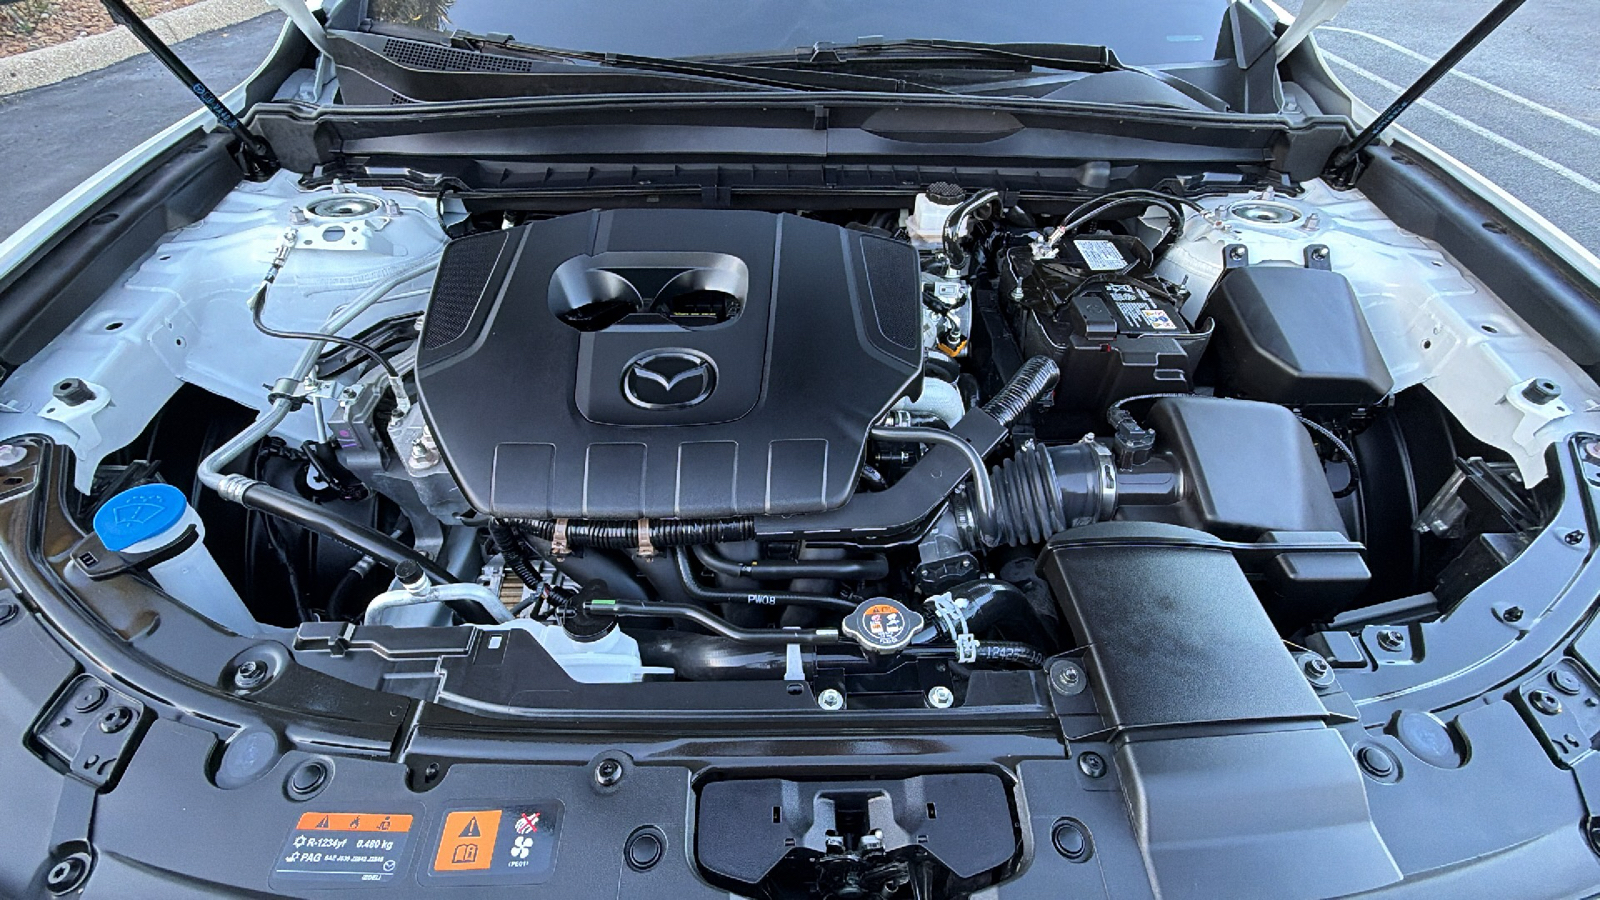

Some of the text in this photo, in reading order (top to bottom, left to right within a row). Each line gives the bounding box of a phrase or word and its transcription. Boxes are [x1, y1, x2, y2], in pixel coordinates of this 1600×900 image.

[747, 594, 776, 606] PW08
[306, 837, 347, 850] R-1234yf
[381, 839, 394, 851] kg
[299, 852, 323, 863] PAG
